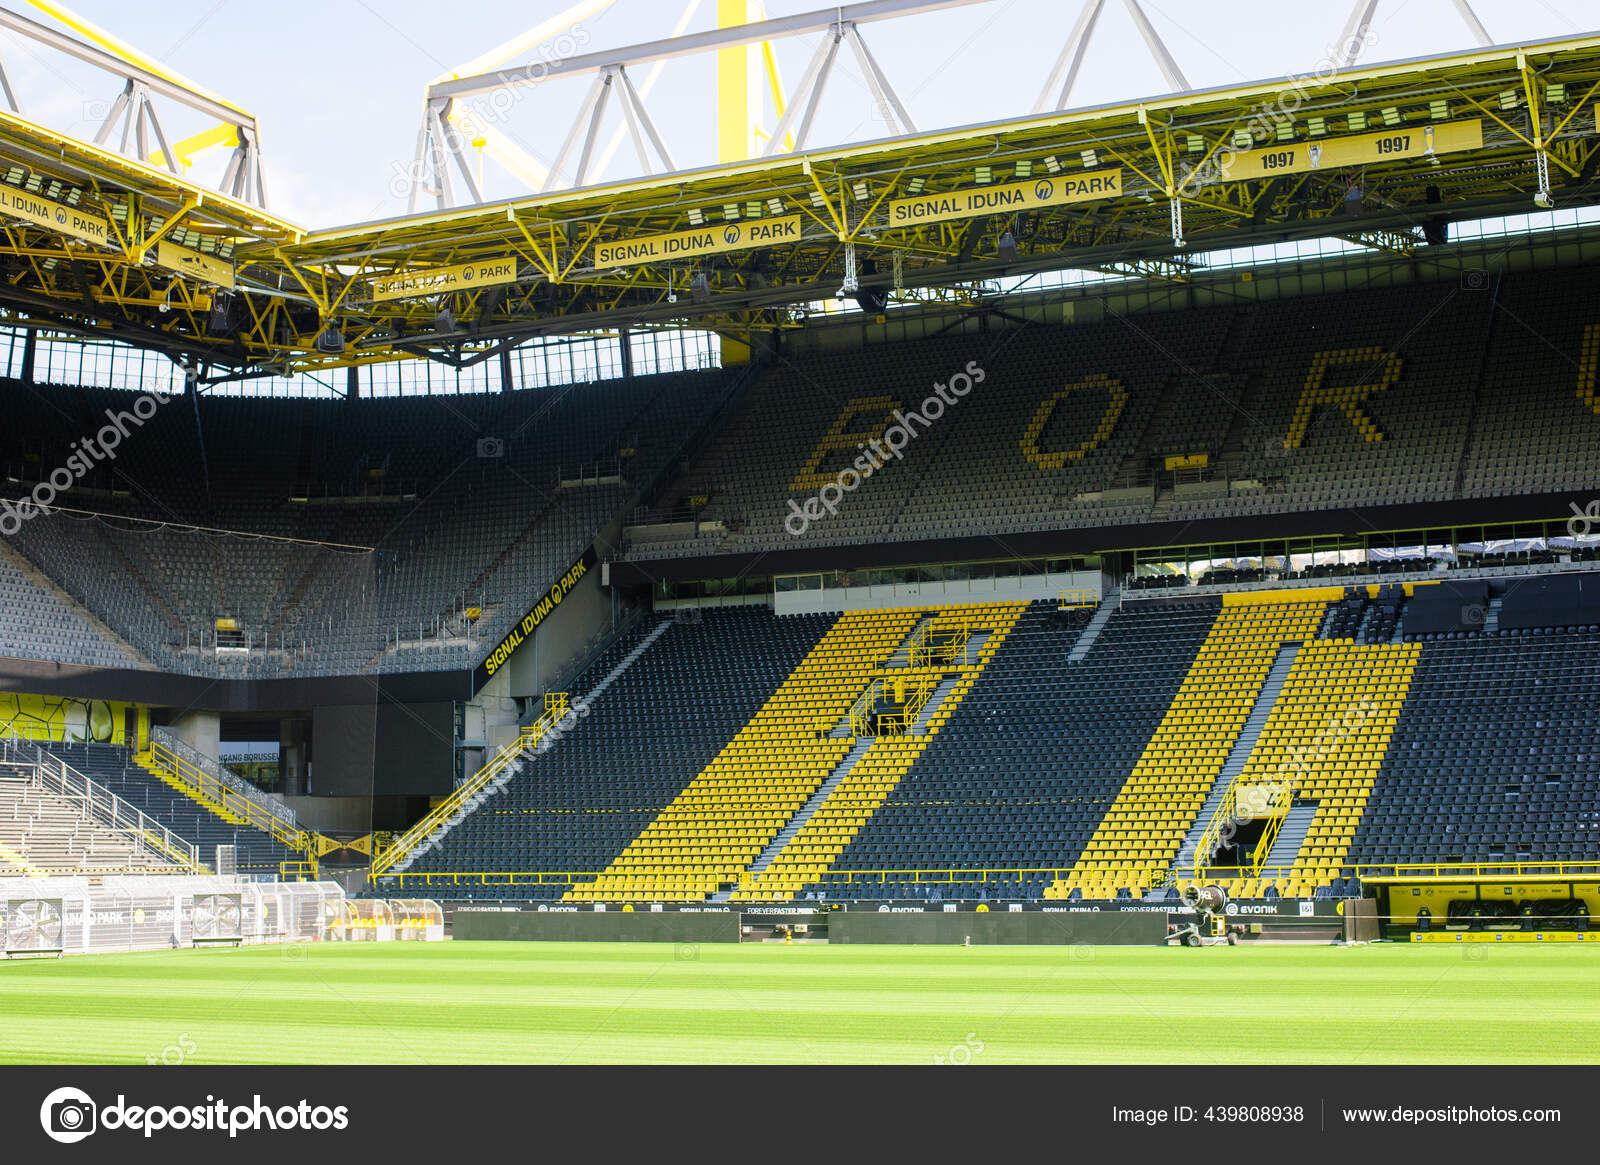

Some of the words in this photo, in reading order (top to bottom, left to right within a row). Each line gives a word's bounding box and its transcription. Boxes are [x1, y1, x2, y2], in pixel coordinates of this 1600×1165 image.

[1261, 151, 1295, 170] 1997
[1375, 136, 1411, 154] 1997
[895, 200, 962, 220] SIGNAL
[967, 189, 1025, 211] IDUNA
[1065, 175, 1117, 196] PARK
[12, 195, 49, 219] IDUNA
[72, 216, 104, 238] PARK
[599, 242, 660, 263] SIGNAL
[664, 233, 715, 254] IDUNA
[750, 220, 797, 241] PARK
[480, 264, 512, 279] PARK
[485, 629, 524, 676] SIGNAL
[521, 596, 554, 636] IDUNA
[560, 557, 587, 594] PARK
[1240, 904, 1278, 914] EVONIK
